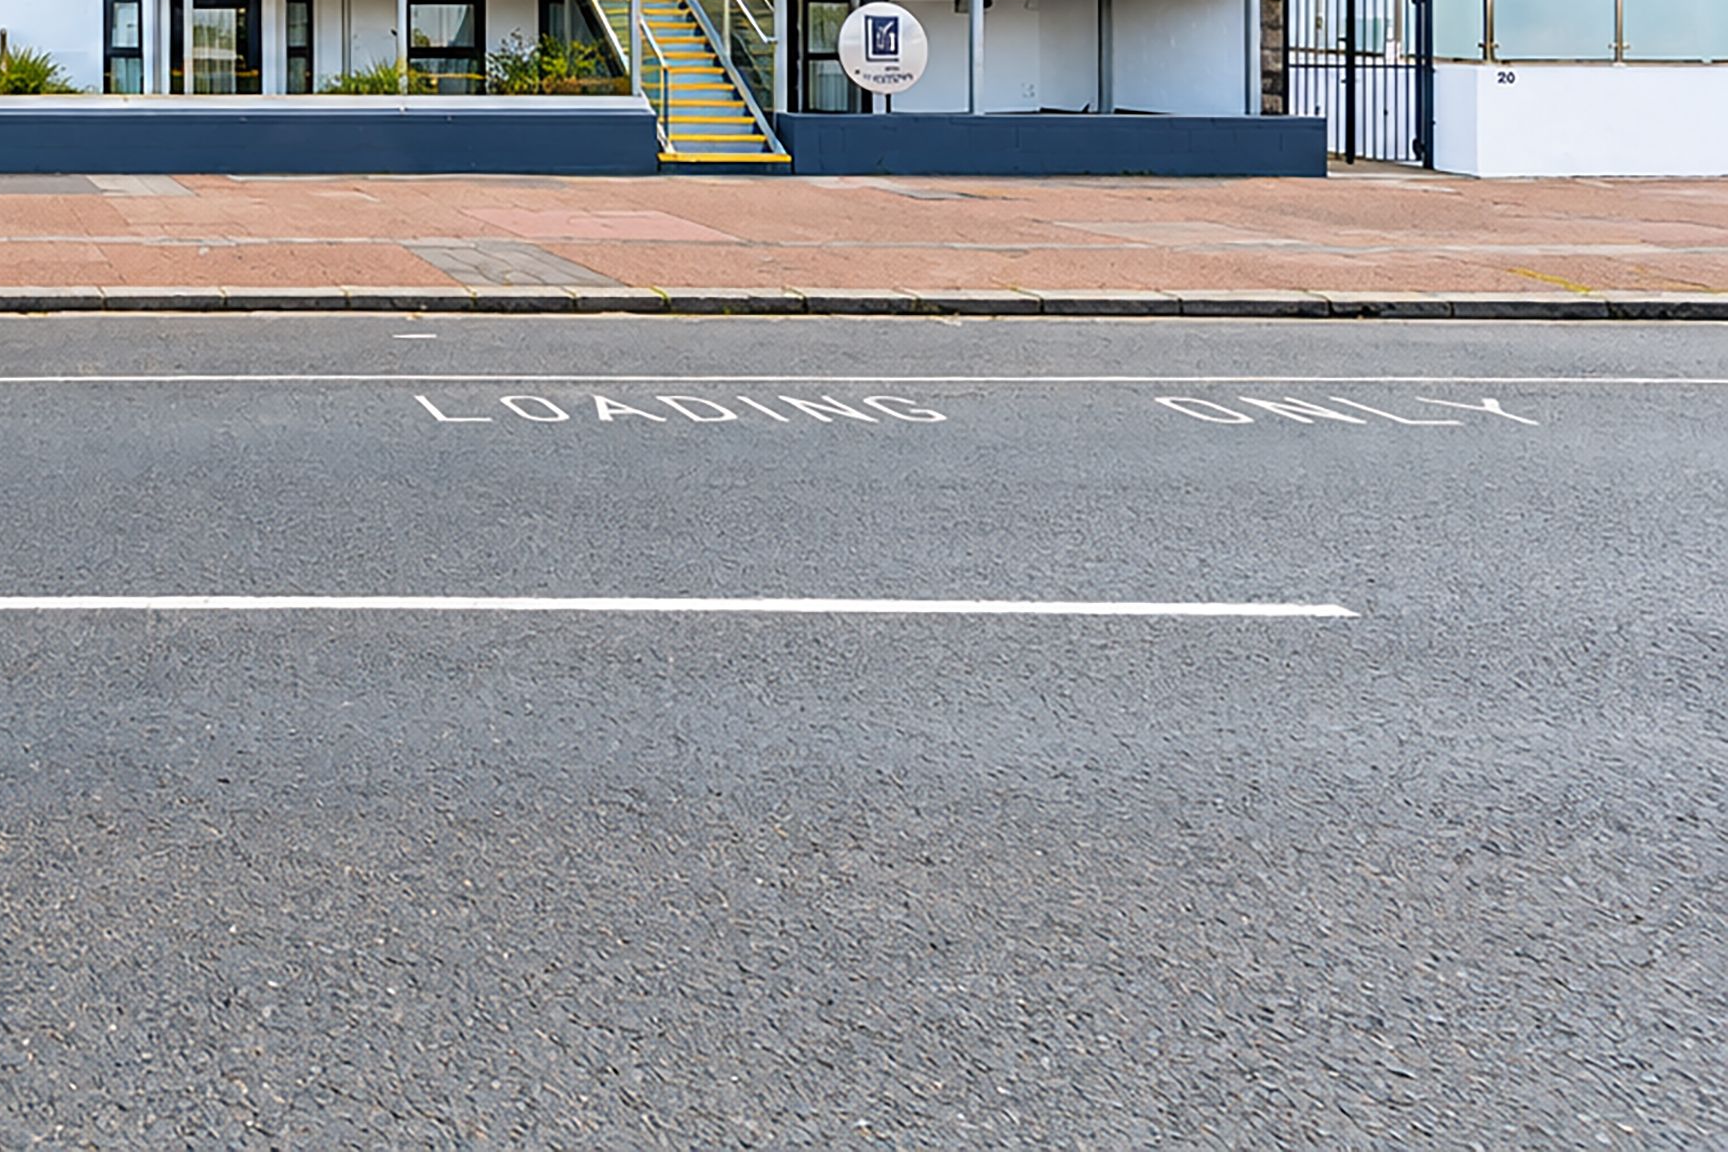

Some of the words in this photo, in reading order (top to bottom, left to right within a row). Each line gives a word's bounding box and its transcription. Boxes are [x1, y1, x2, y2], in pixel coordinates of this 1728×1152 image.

[1497, 71, 1516, 84] 20
[414, 394, 948, 422] LOADING
[1154, 395, 1540, 426] ONLY
